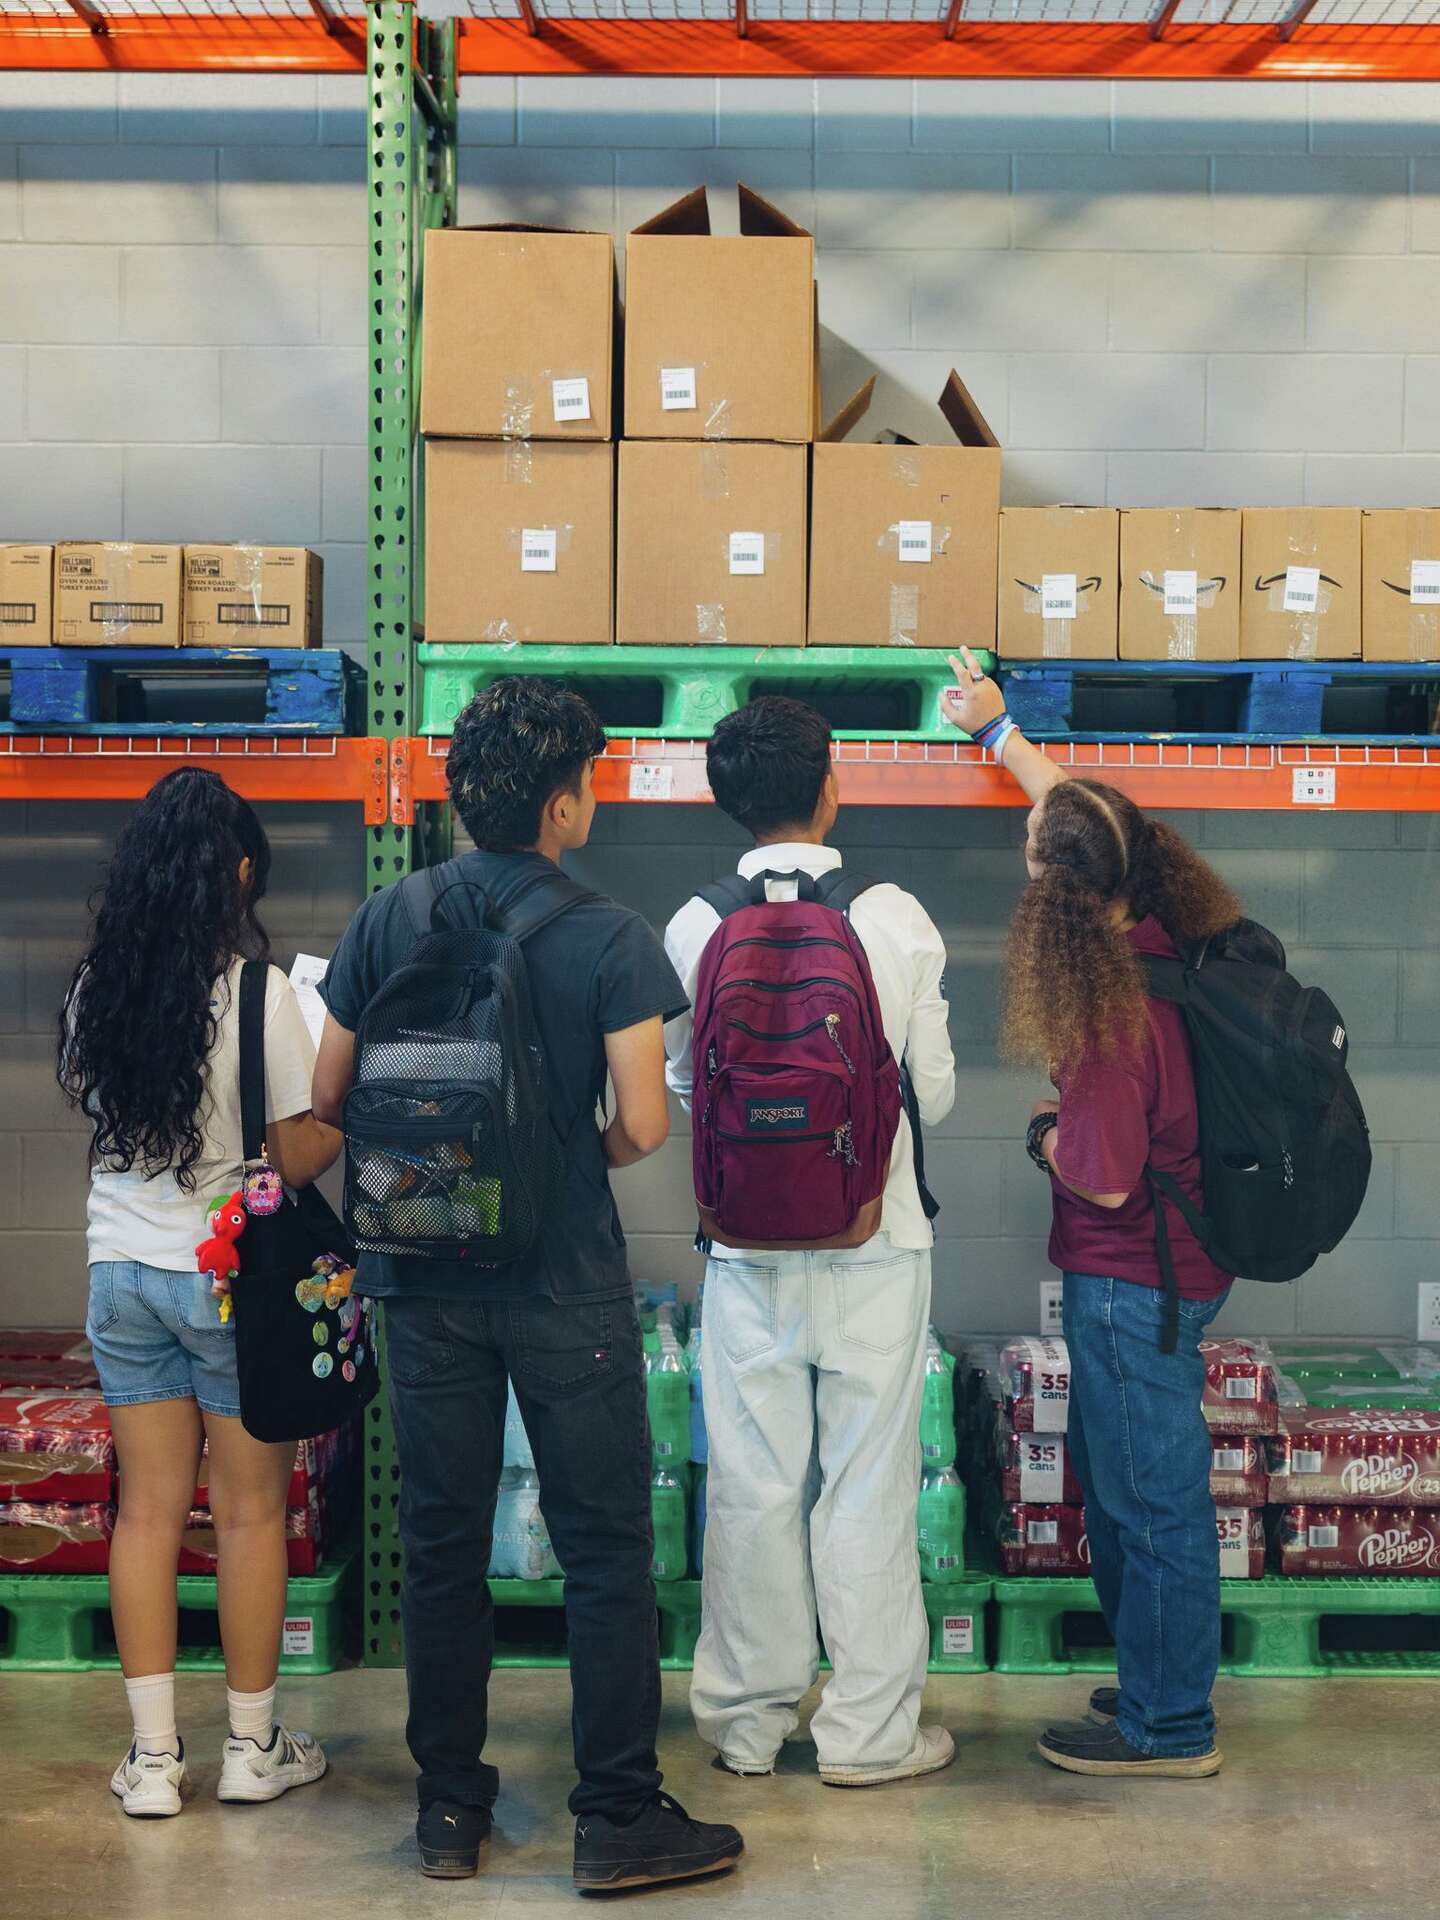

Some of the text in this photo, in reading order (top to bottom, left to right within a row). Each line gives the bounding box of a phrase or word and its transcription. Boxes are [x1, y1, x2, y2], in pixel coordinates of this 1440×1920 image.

[1041, 1373, 1068, 1392] 35
[1041, 1391, 1068, 1400] cans
[1028, 1444, 1056, 1462] 35
[1028, 1463, 1056, 1471] cans
[1367, 1455, 1395, 1475] Dr
[1343, 1458, 1412, 1494] Pepper
[1423, 1479, 1440, 1493] 23
[1217, 1519, 1242, 1540] 35
[1384, 1529, 1411, 1548] Dr
[1220, 1541, 1241, 1550] ans
[1360, 1533, 1428, 1567] Pepper
